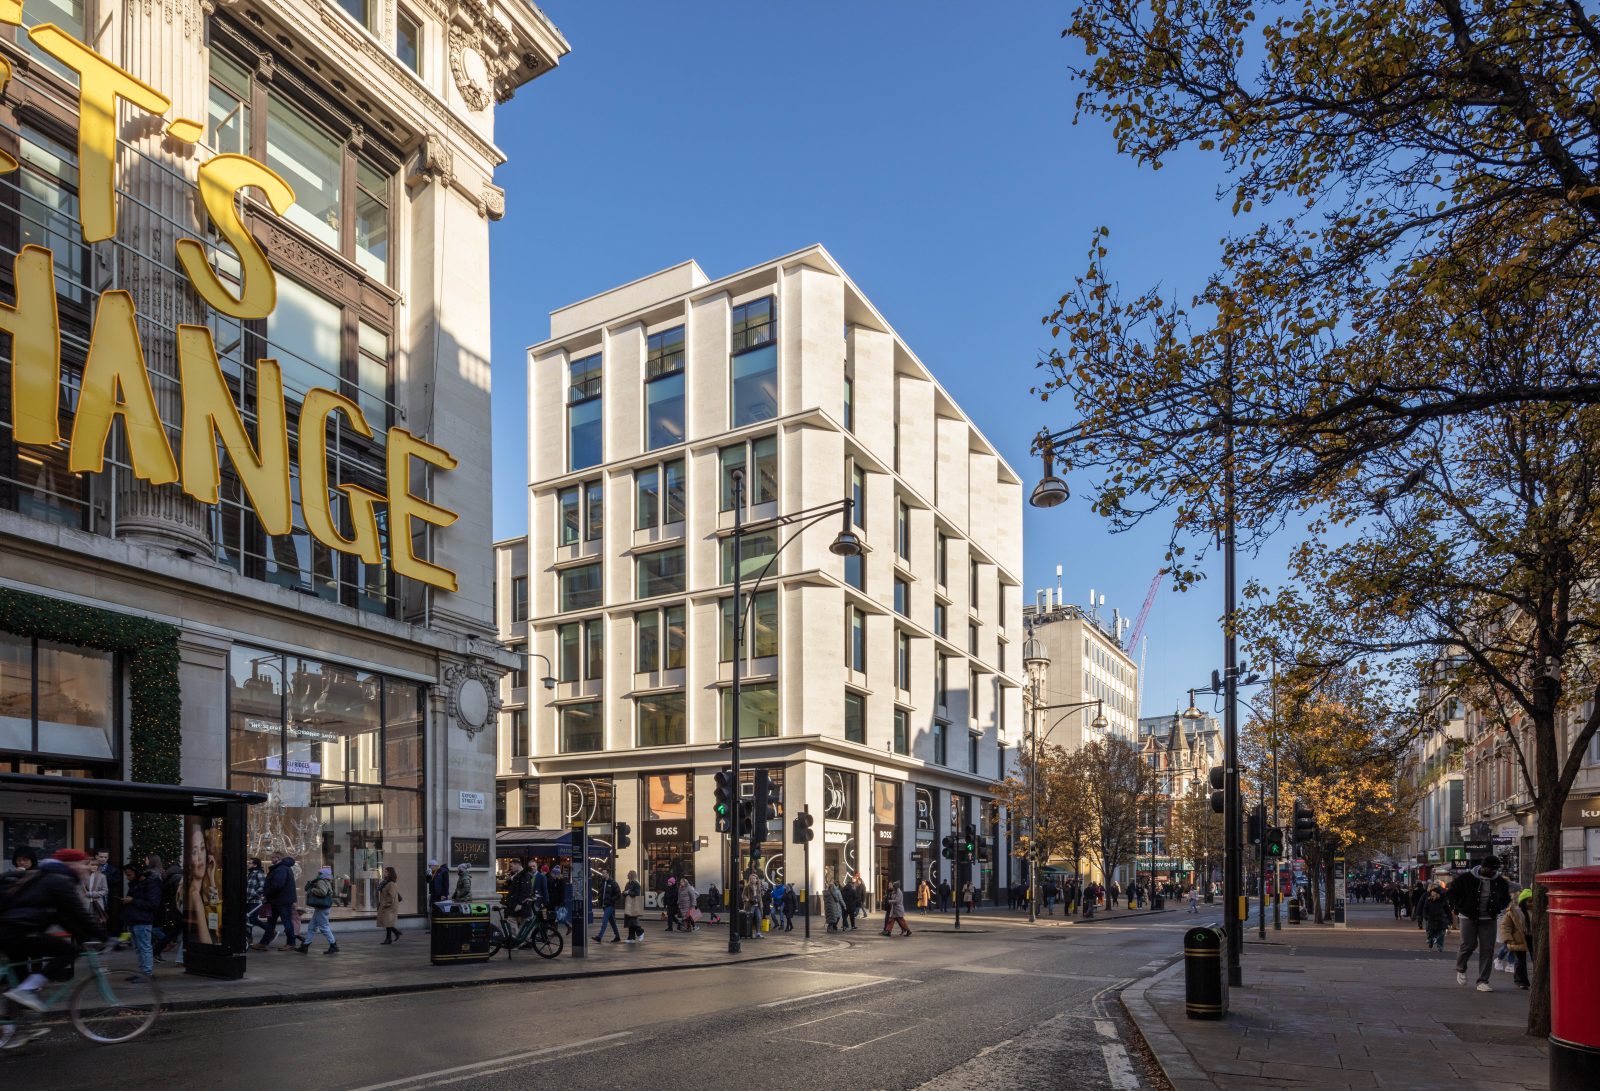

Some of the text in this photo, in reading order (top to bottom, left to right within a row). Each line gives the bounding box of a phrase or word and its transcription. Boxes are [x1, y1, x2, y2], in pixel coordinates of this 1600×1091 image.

[0, 0, 296, 320] T'S
[655, 827, 678, 836] BOSS
[879, 830, 892, 839] BOSS
